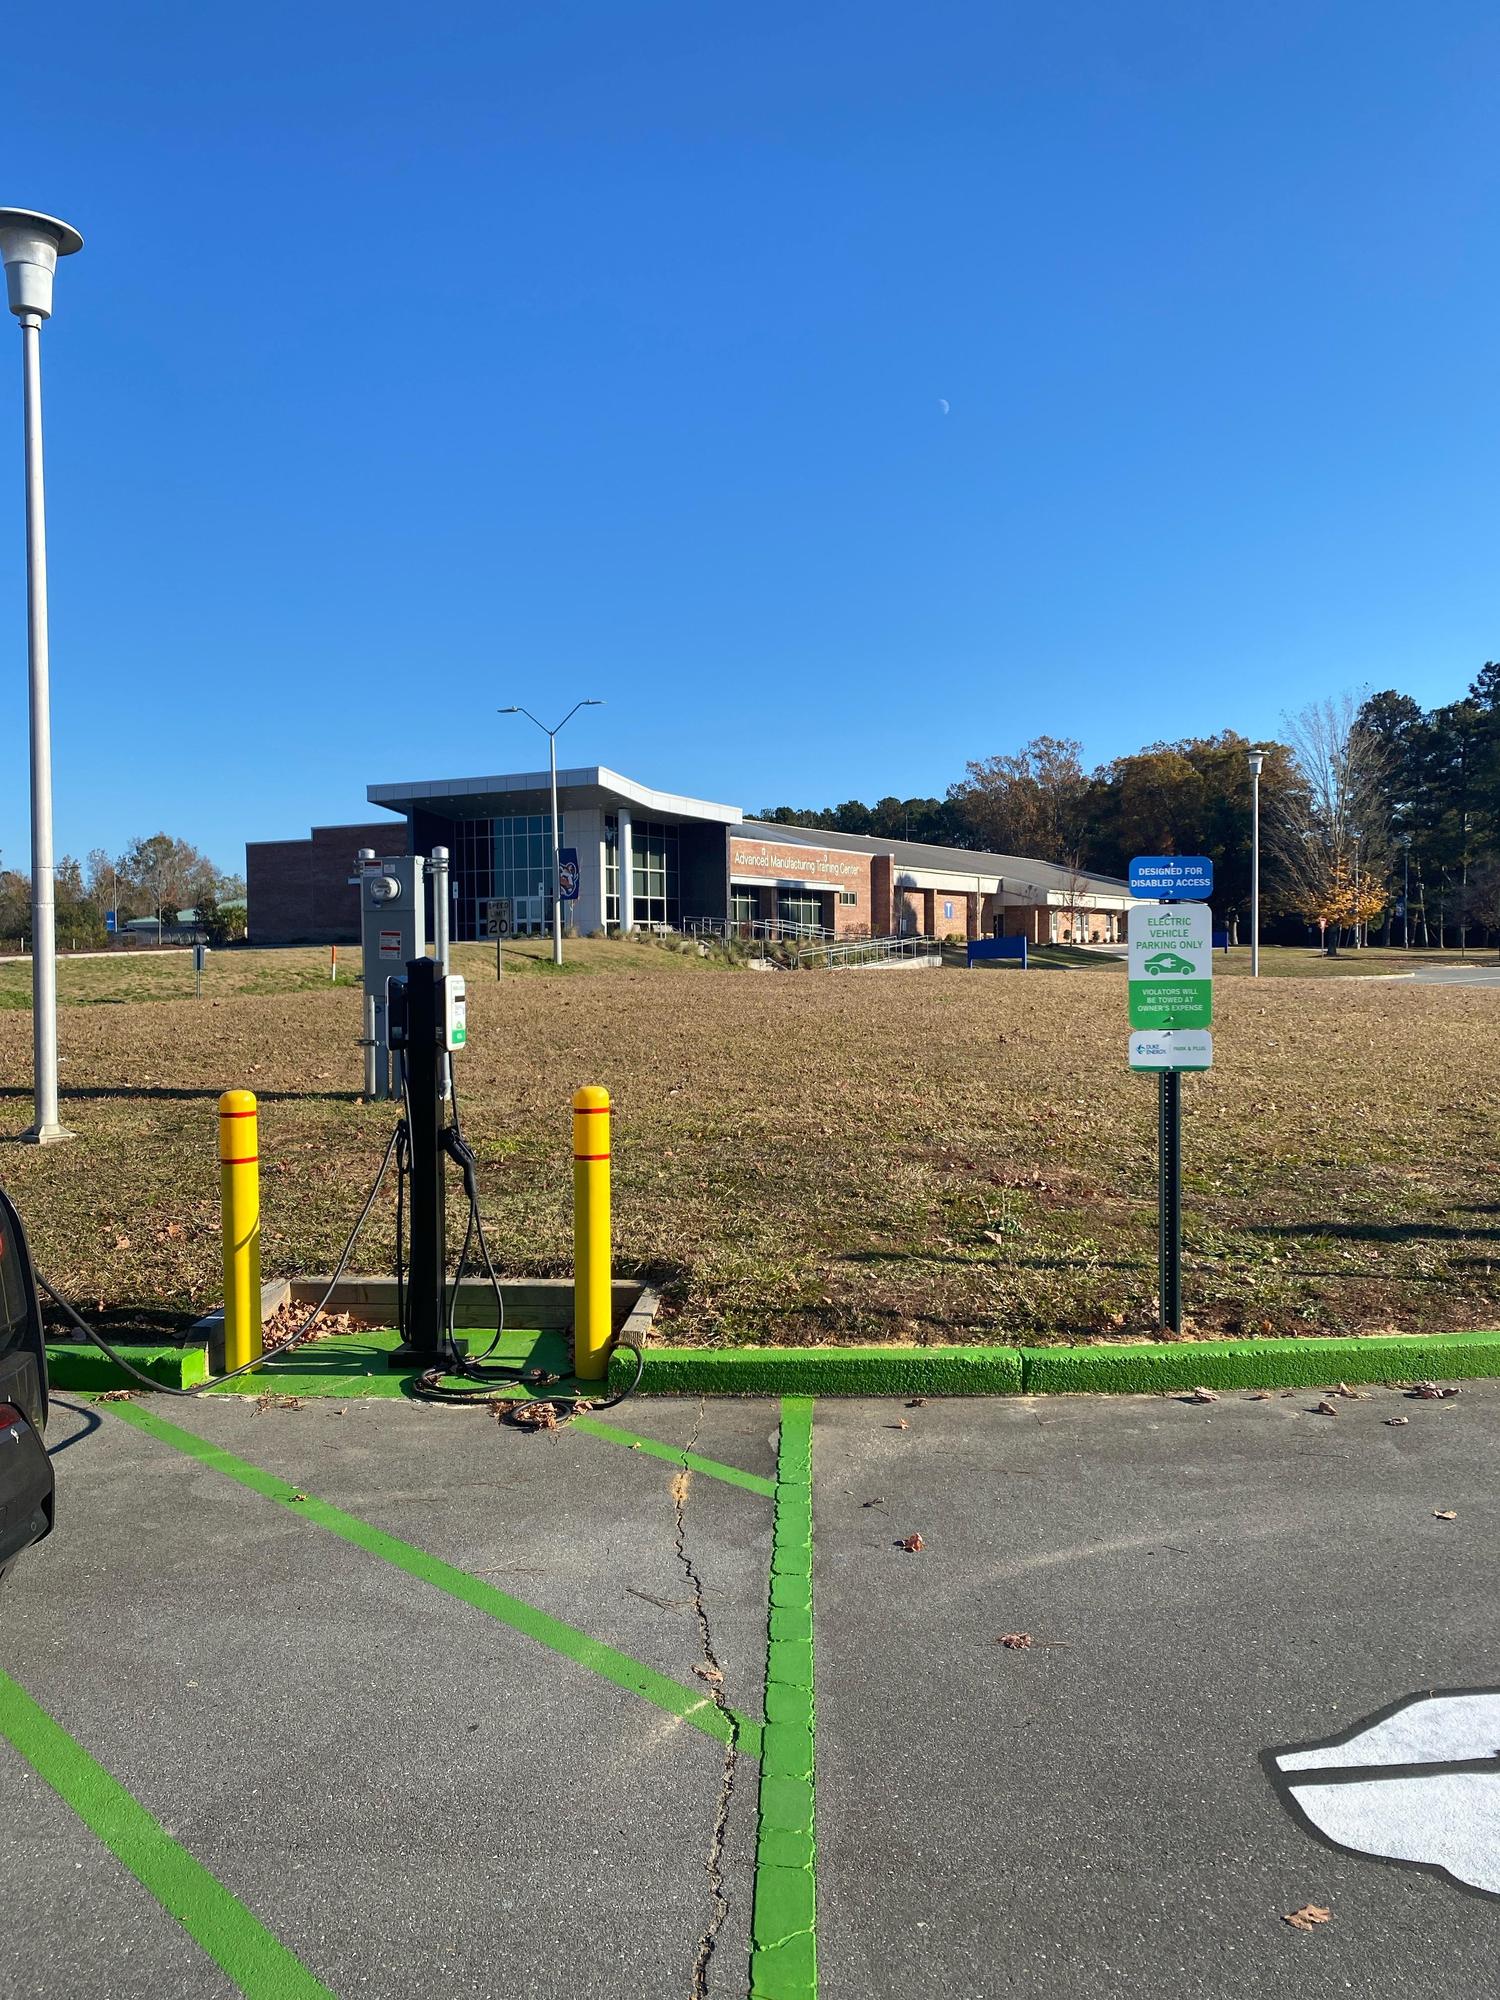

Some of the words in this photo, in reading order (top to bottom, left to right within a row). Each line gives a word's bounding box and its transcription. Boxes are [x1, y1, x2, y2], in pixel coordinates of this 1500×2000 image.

[734, 851, 768, 867] Advanced
[770, 856, 816, 874] Manufacturing
[816, 860, 839, 875] Training
[839, 862, 860, 875] Center
[1138, 867, 1182, 876] DESIGNED
[1184, 867, 1203, 875] FOR
[1131, 879, 1174, 887] DISABLED
[1175, 878, 1211, 887] ACCESS
[1147, 917, 1191, 926] ELECTRIC
[488, 919, 508, 934] 20
[1150, 929, 1189, 938] VEHICLE
[1136, 941, 1177, 950] PARKING
[1179, 940, 1204, 949] ONLY
[1142, 988, 1181, 996] VIOLATORS
[1146, 996, 1156, 1004] BE
[1157, 996, 1183, 1004] TOWED
[1137, 1004, 1170, 1012] OWNER'S
[1171, 1004, 1204, 1012] EXPENSE
